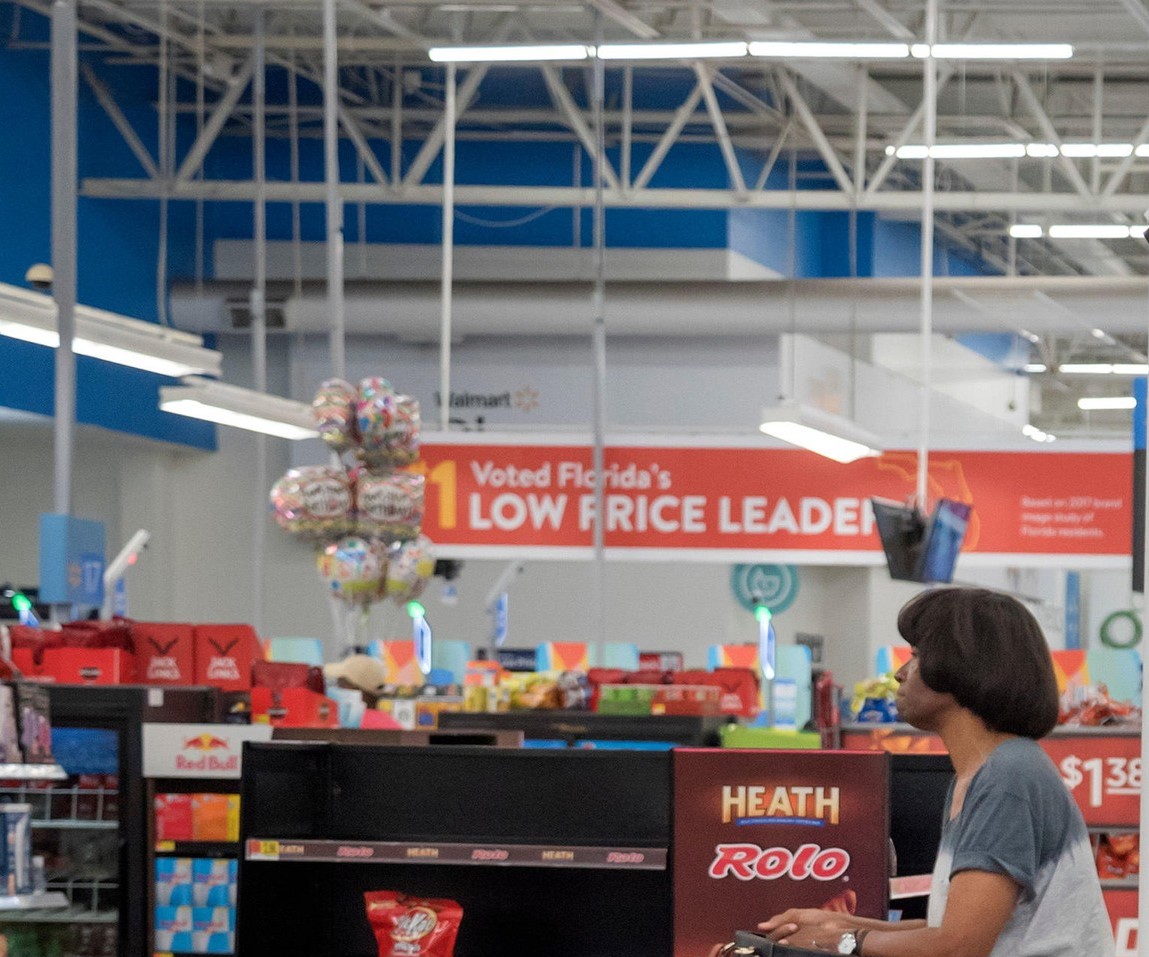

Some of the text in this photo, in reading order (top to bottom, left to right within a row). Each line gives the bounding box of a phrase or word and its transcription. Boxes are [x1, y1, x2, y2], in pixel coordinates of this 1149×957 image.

[470, 461, 672, 489] Voted Florida's
[469, 494, 568, 531] LOW
[578, 495, 707, 533] PRICE
[176, 754, 239, 771] Red Bull
[722, 785, 840, 825] HEATH
[279, 845, 305, 855] EATH
[708, 843, 850, 882] Rolo
